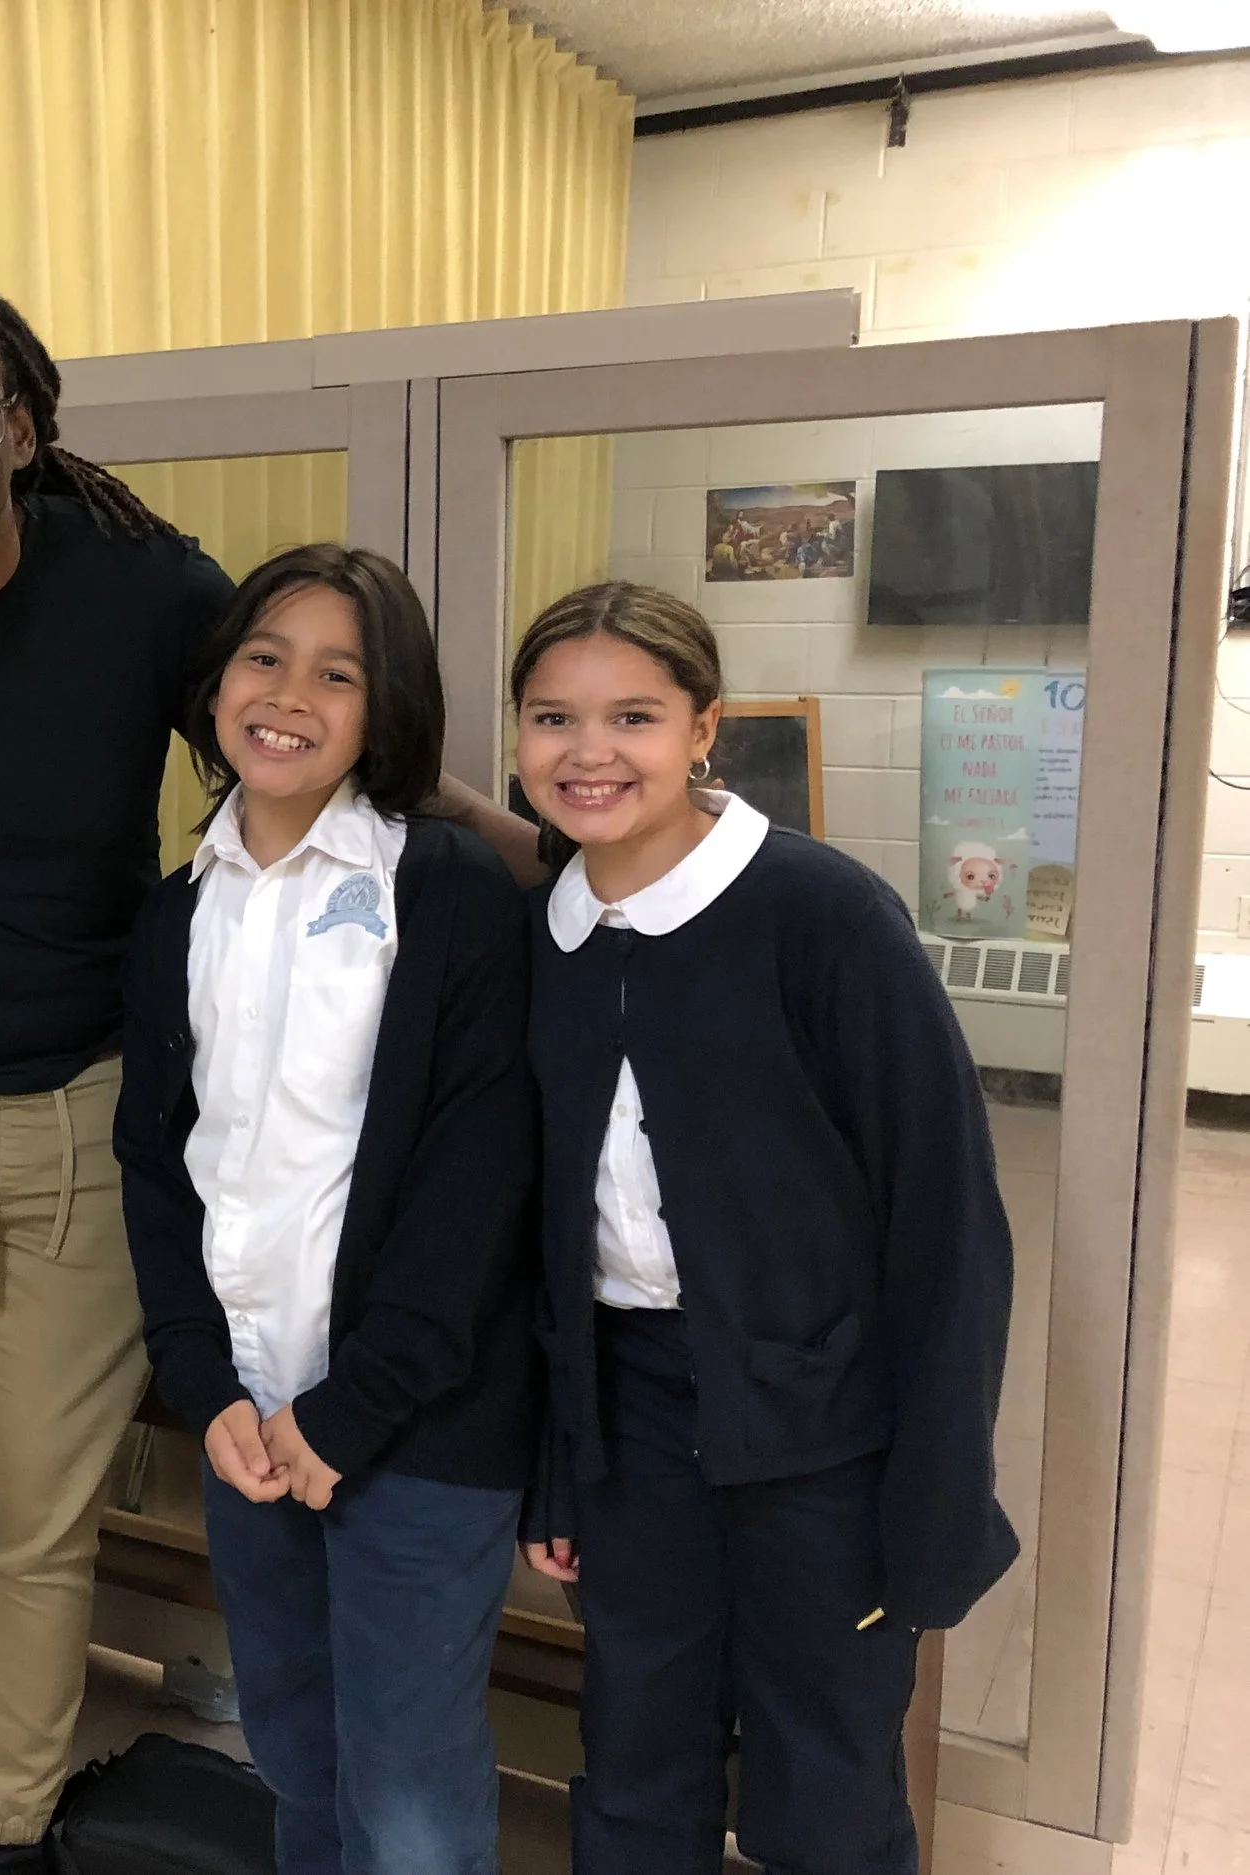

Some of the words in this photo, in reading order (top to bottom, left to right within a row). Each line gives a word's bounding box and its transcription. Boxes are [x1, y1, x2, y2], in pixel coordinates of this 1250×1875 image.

[1044, 680, 1086, 711] 10
[954, 704, 966, 723] EL
[962, 761, 997, 778] NADA
[944, 787, 962, 804] ME
